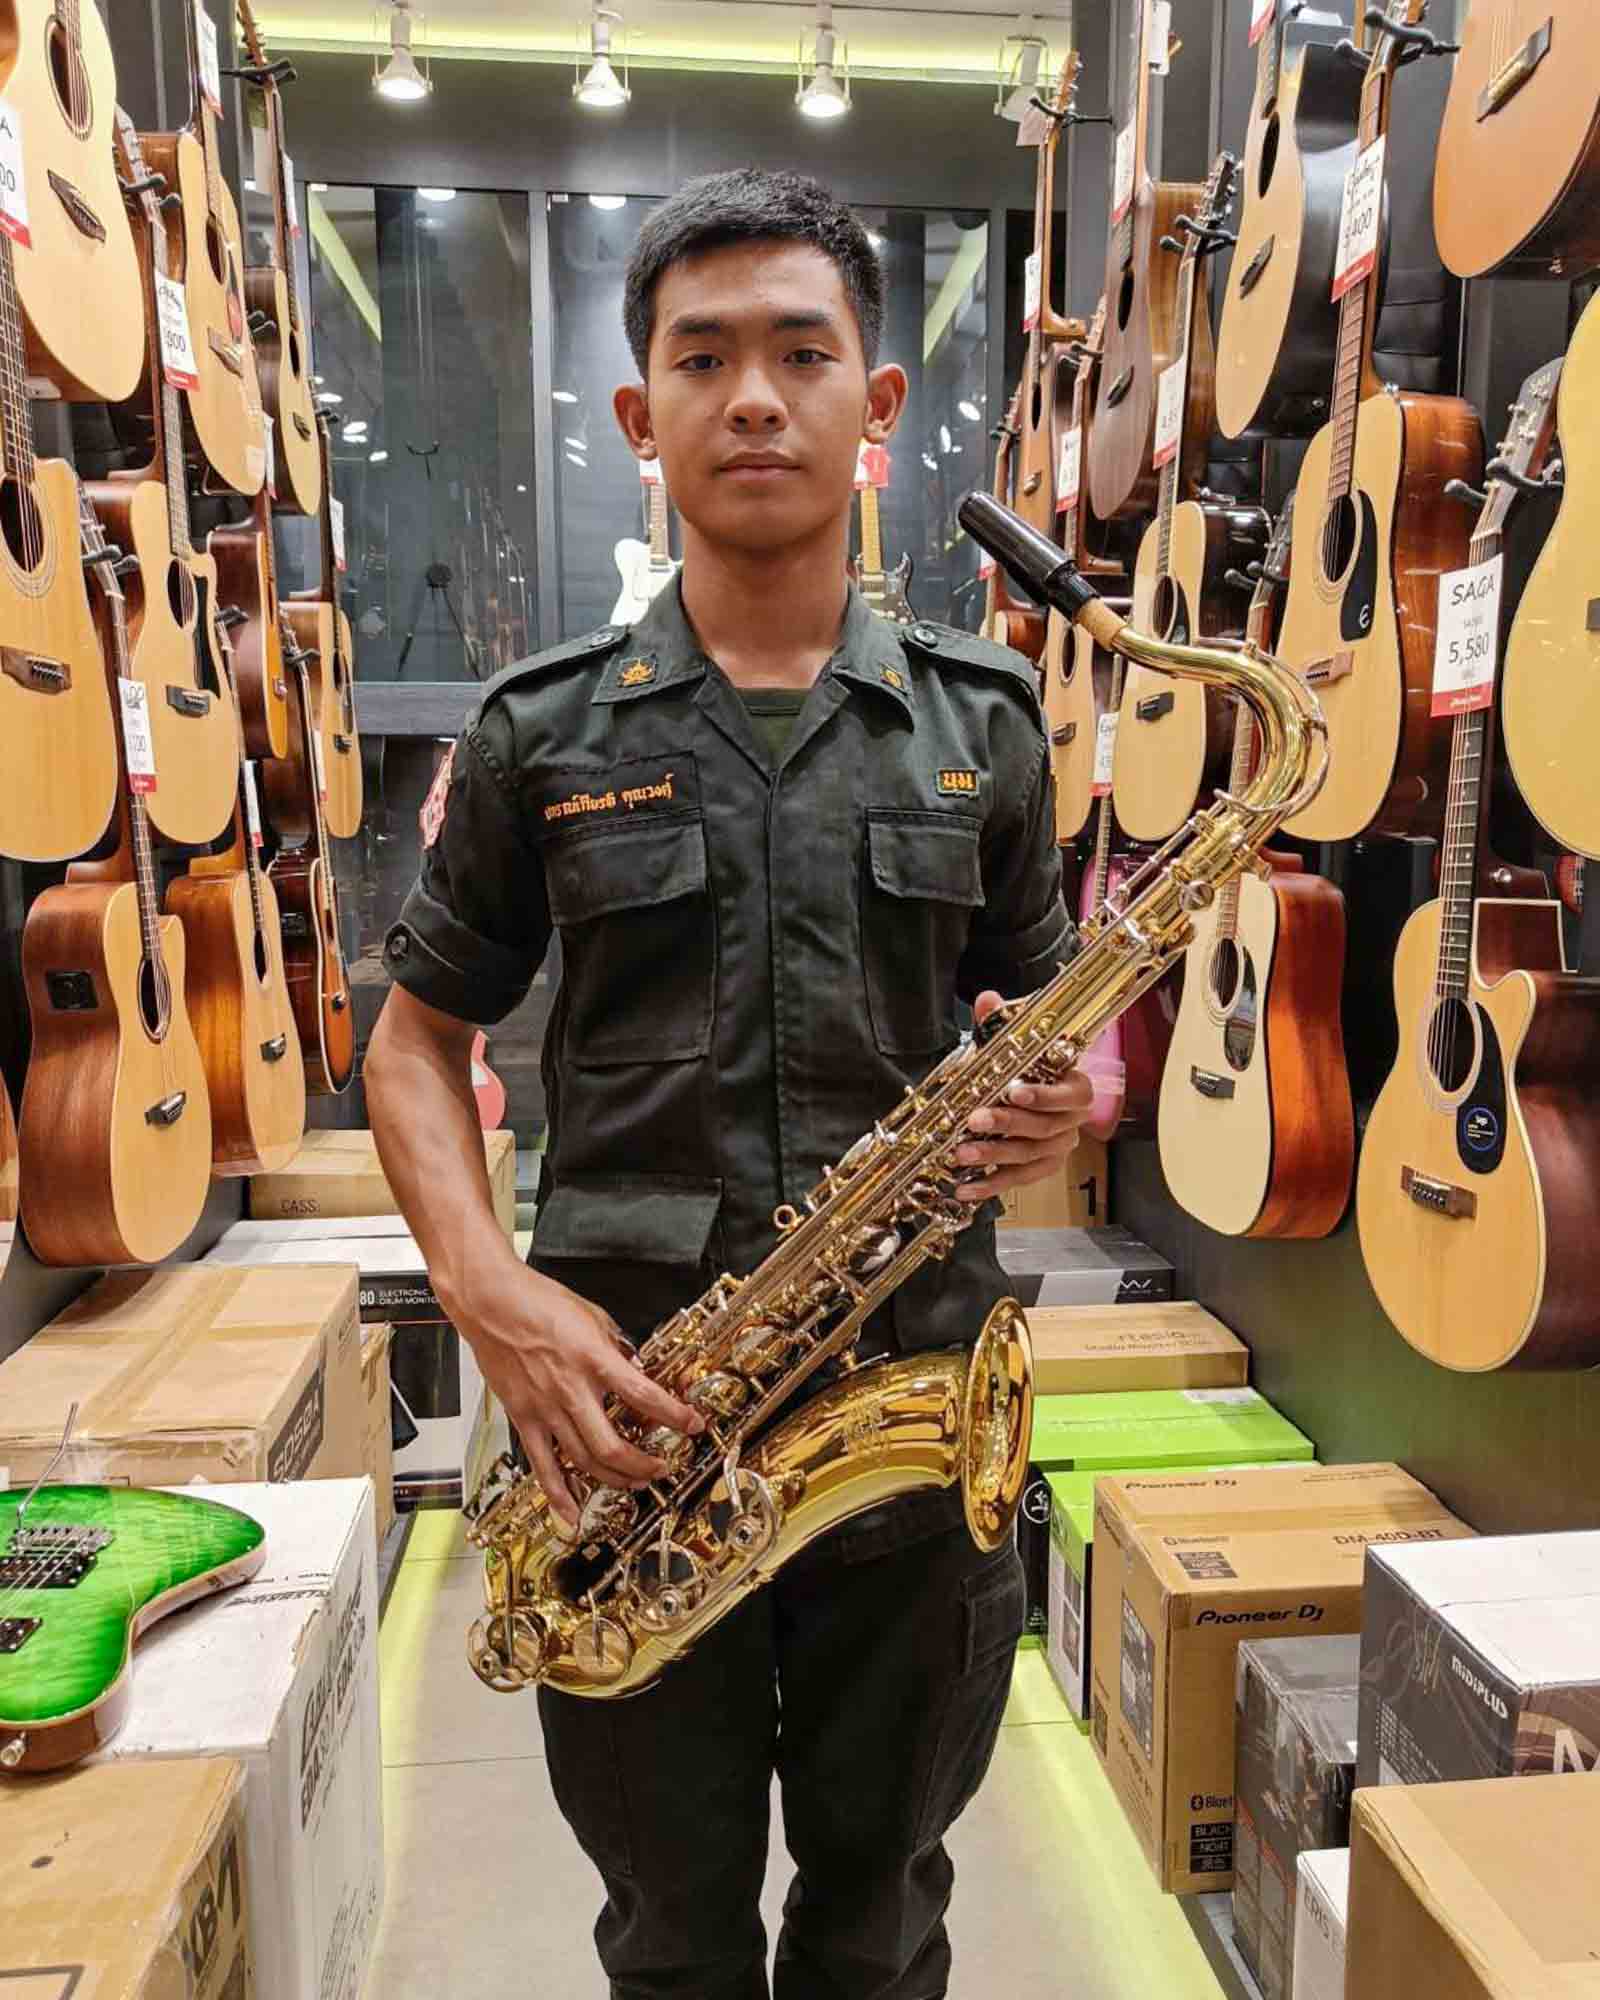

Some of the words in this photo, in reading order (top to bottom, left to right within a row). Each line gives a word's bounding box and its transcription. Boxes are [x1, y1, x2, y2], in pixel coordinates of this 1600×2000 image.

[1451, 575, 1494, 606] SAGA
[1448, 633, 1489, 664] 5,580
[404, 1296, 438, 1305] MONITO
[1196, 1609, 1292, 1626] Pioneer
